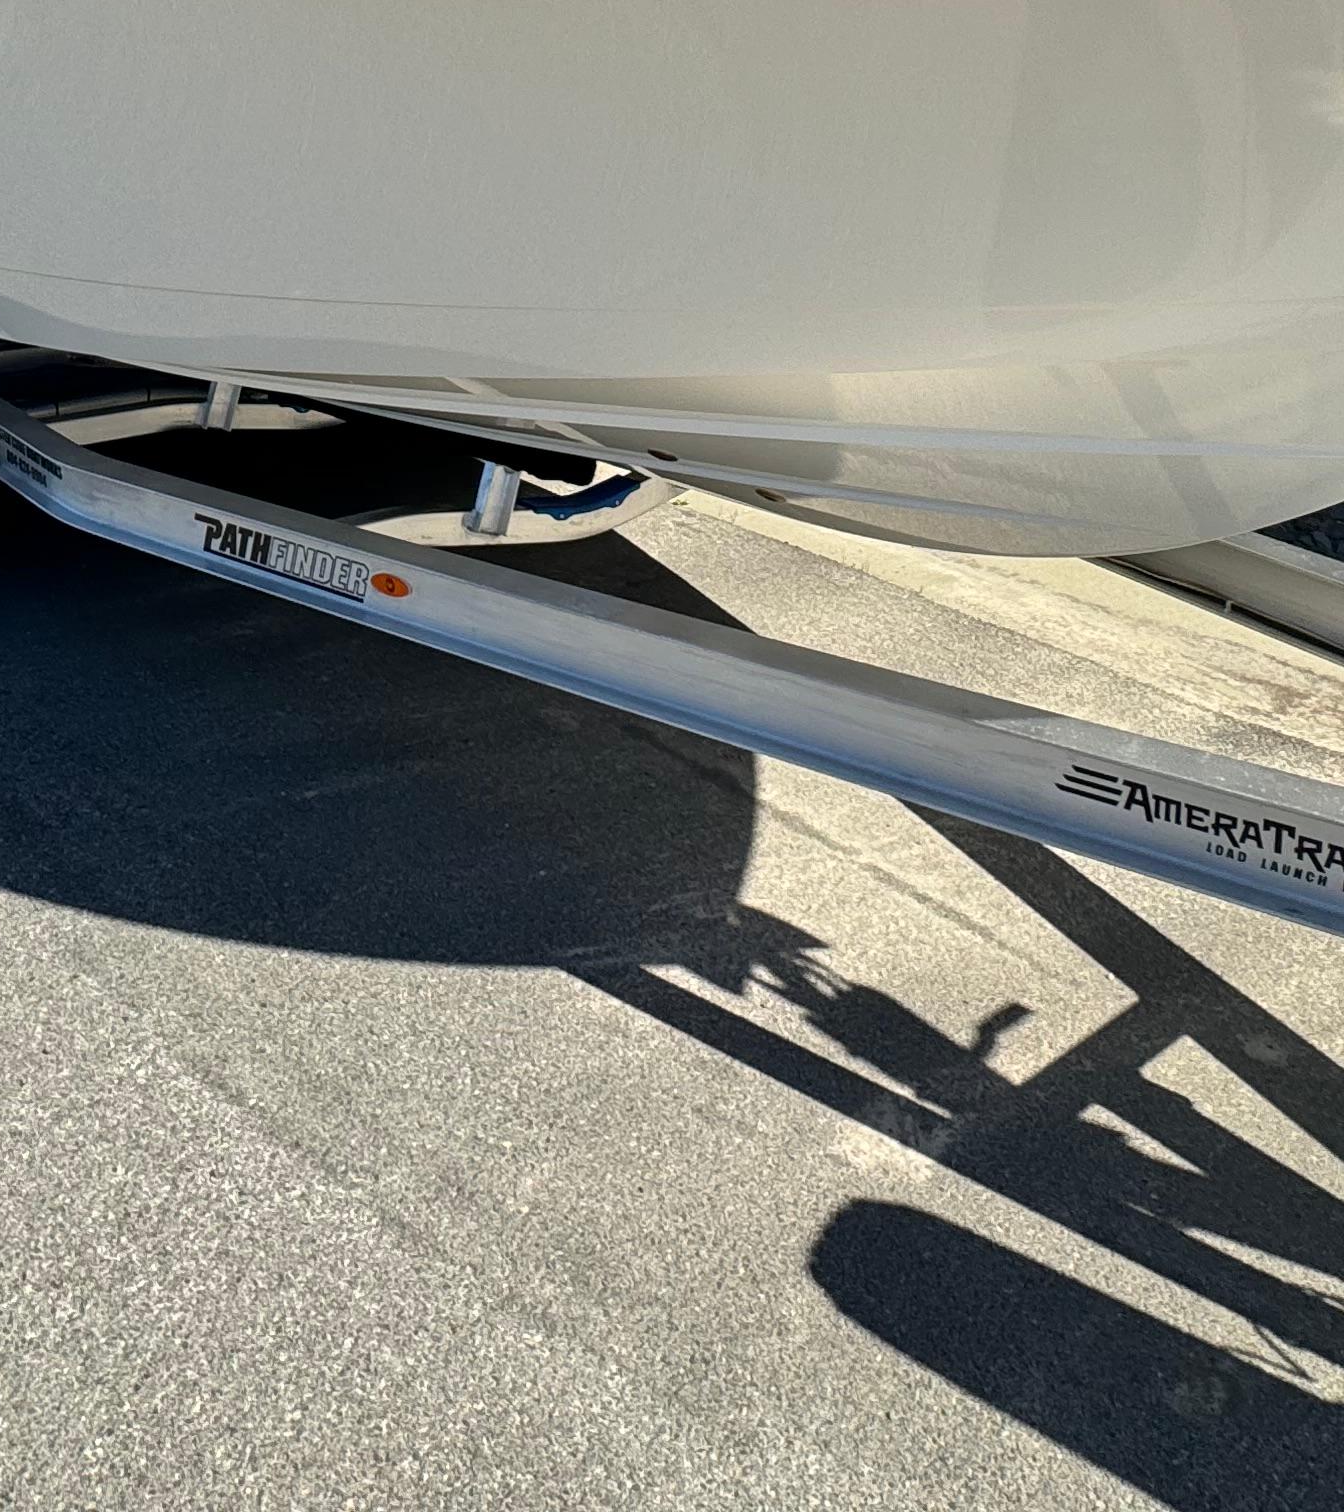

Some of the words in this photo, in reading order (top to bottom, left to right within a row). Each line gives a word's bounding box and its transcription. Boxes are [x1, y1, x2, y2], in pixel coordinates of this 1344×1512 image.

[194, 512, 369, 599] PATHFINDER
[1206, 842, 1248, 863] LOAD
[1260, 858, 1329, 888] LAUNCH
